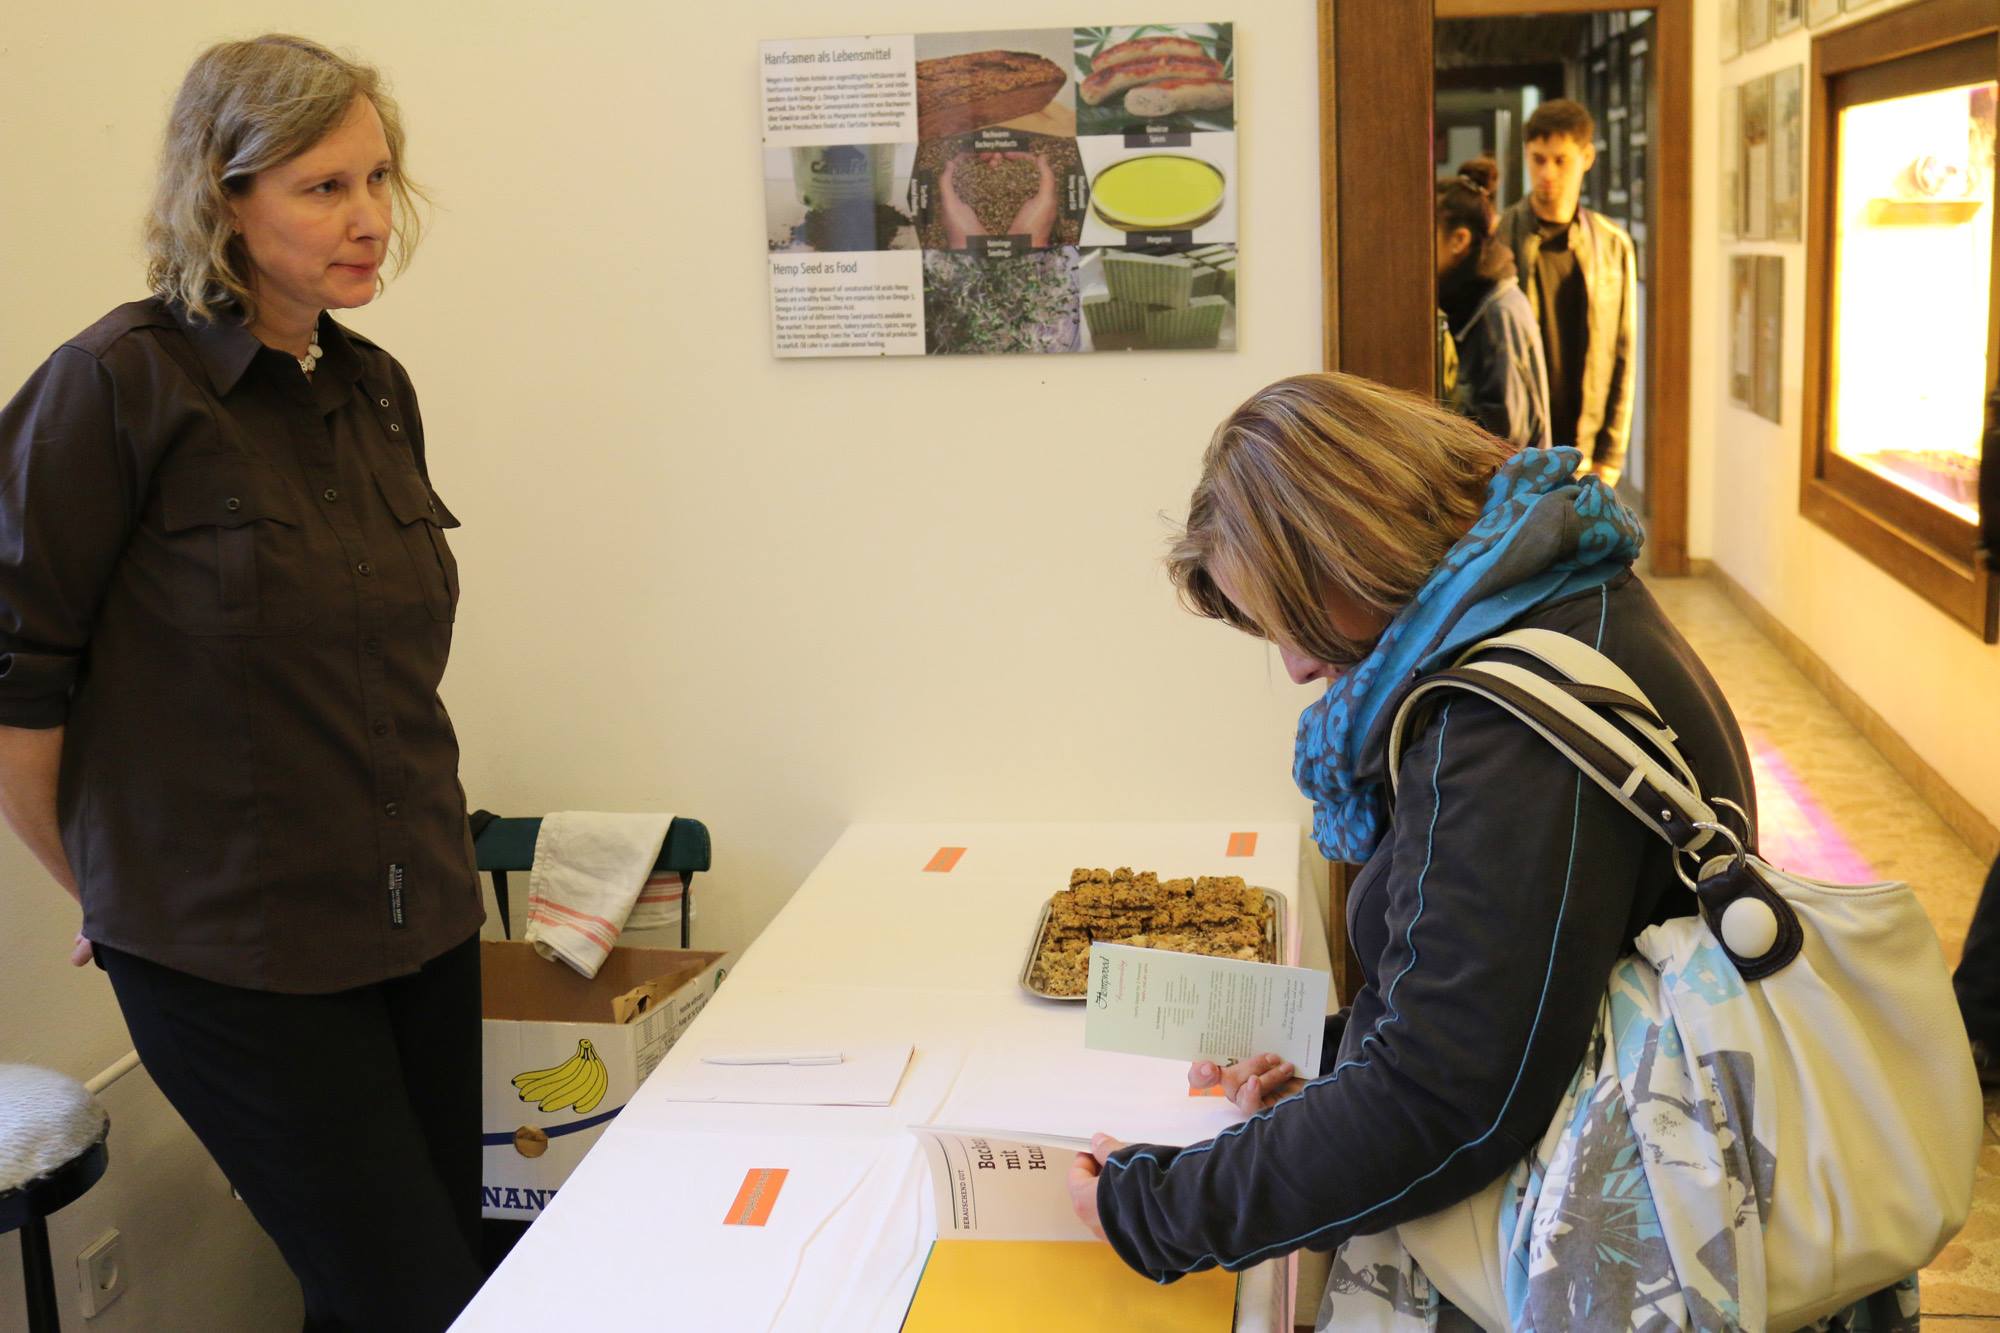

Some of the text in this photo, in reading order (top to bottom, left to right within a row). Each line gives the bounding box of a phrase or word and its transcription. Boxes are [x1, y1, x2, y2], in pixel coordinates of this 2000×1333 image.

[765, 48, 891, 65] Hanfsamen als Lebensmittel
[773, 261, 857, 276] Hemp Seed as Food
[1000, 1150, 1021, 1170] mit
[958, 1170, 970, 1230] BERAUSCHEND GUT
